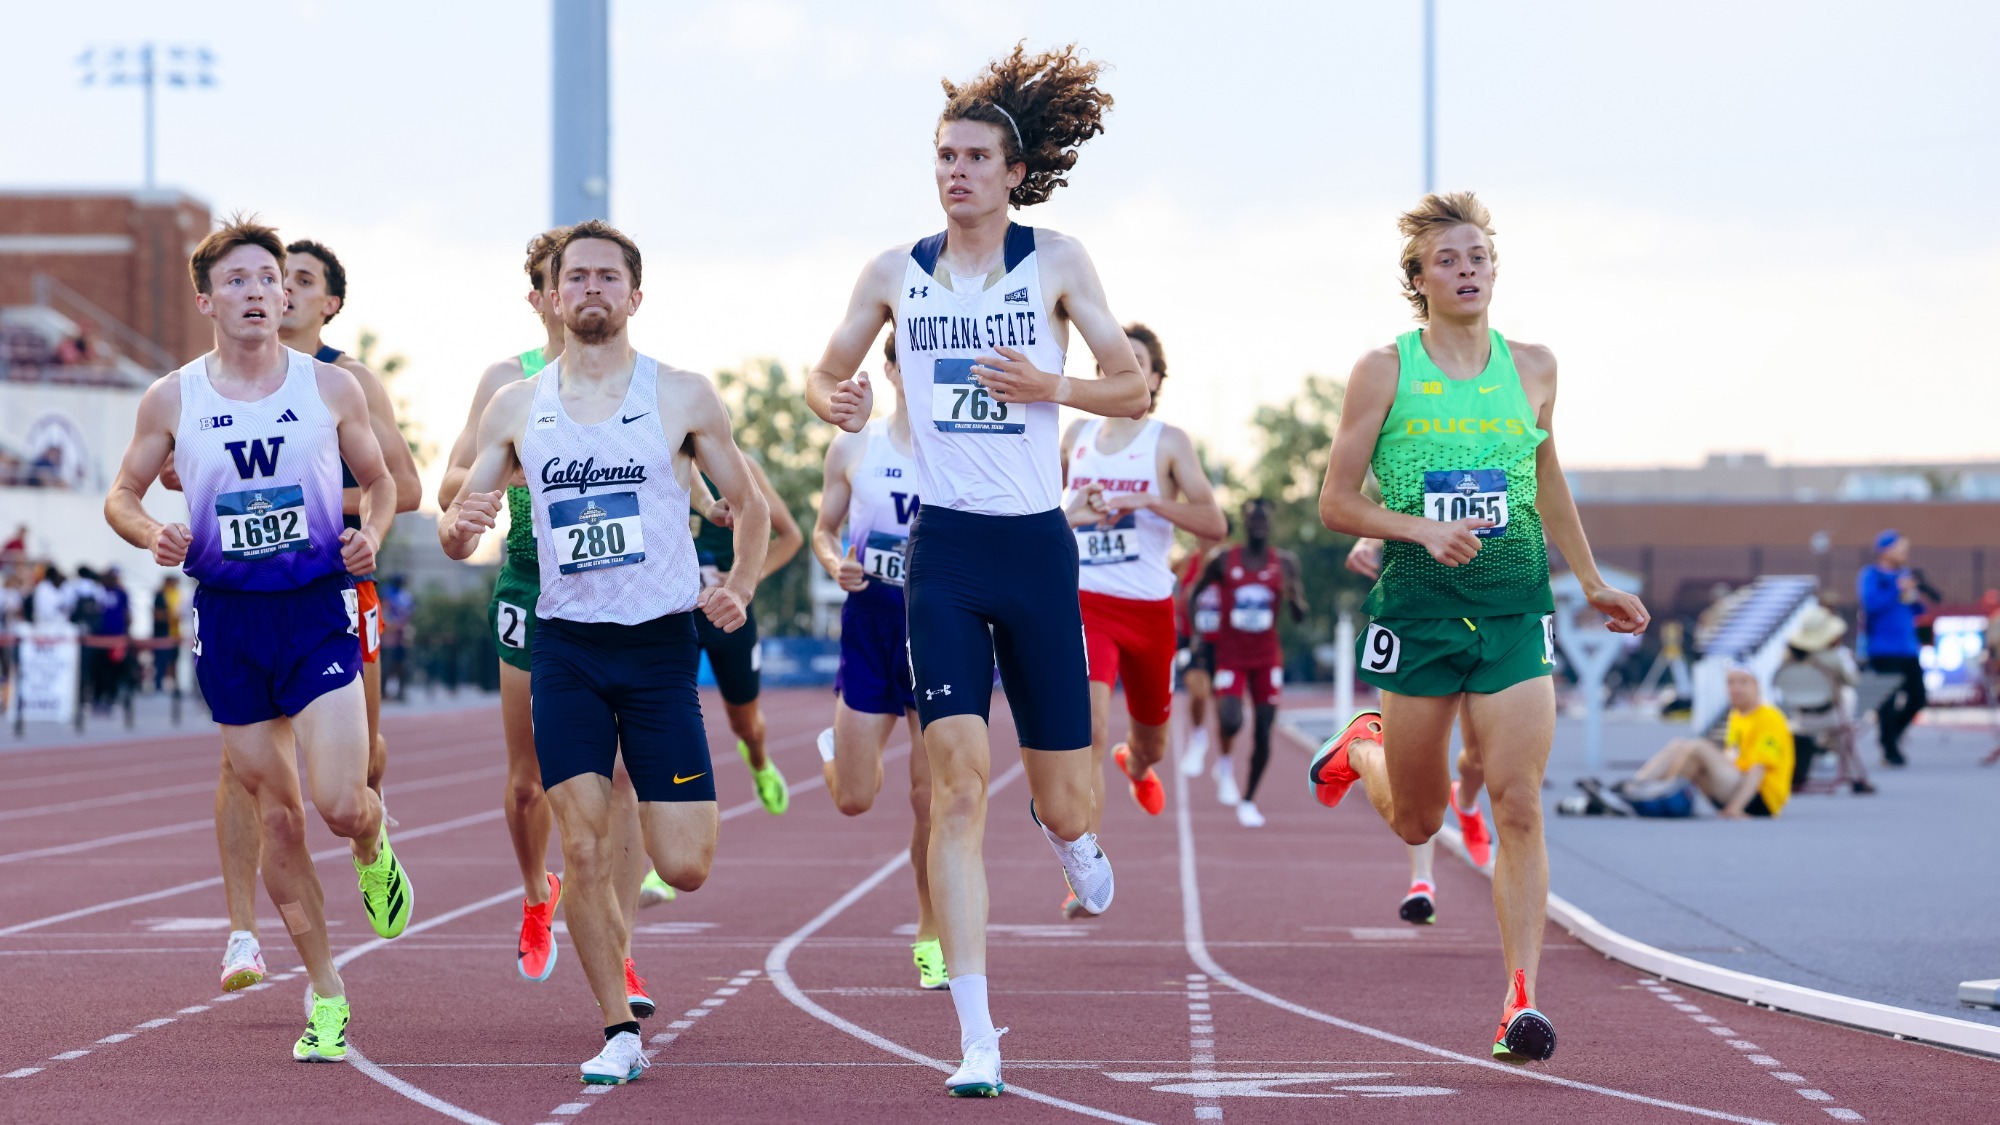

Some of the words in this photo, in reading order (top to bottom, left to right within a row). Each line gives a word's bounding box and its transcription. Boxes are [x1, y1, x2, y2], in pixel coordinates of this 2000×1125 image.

[908, 315, 982, 351] MONTANA
[986, 311, 1037, 348] STATE
[537, 416, 556, 424] ACC
[951, 388, 1008, 421] 763
[1406, 418, 1524, 435] DUCKS
[224, 436, 285, 480] W
[541, 457, 647, 494] California
[1434, 495, 1502, 526] 1055
[229, 510, 301, 549] 1692
[568, 522, 626, 561] 280
[1088, 534, 1125, 556] 844
[873, 554, 905, 579] 16
[503, 607, 518, 647] 2
[1370, 629, 1394, 670] 9
